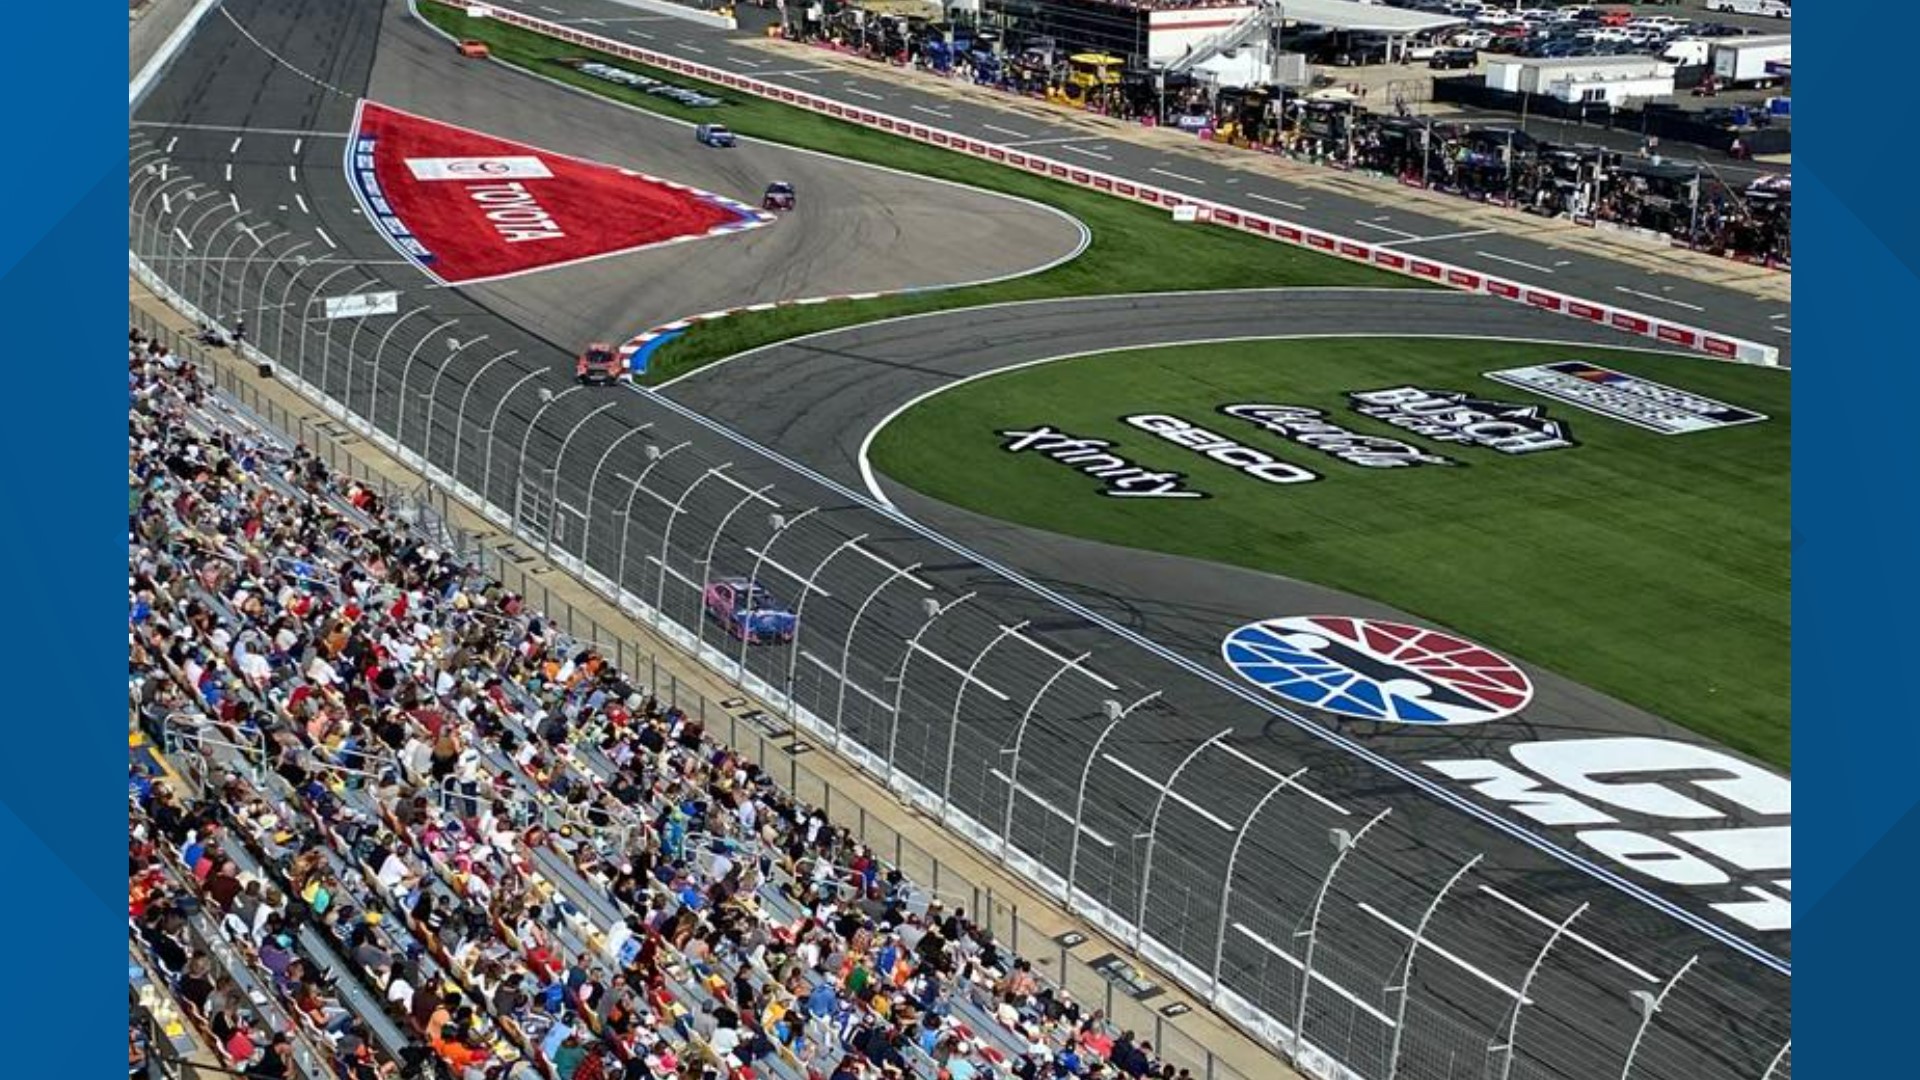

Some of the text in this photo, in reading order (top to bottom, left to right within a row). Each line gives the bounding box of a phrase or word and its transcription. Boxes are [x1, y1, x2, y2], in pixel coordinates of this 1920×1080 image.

[465, 182, 566, 243] TOYOTA
[1126, 415, 1317, 483] GEICO
[1351, 387, 1573, 454] BUSCH
